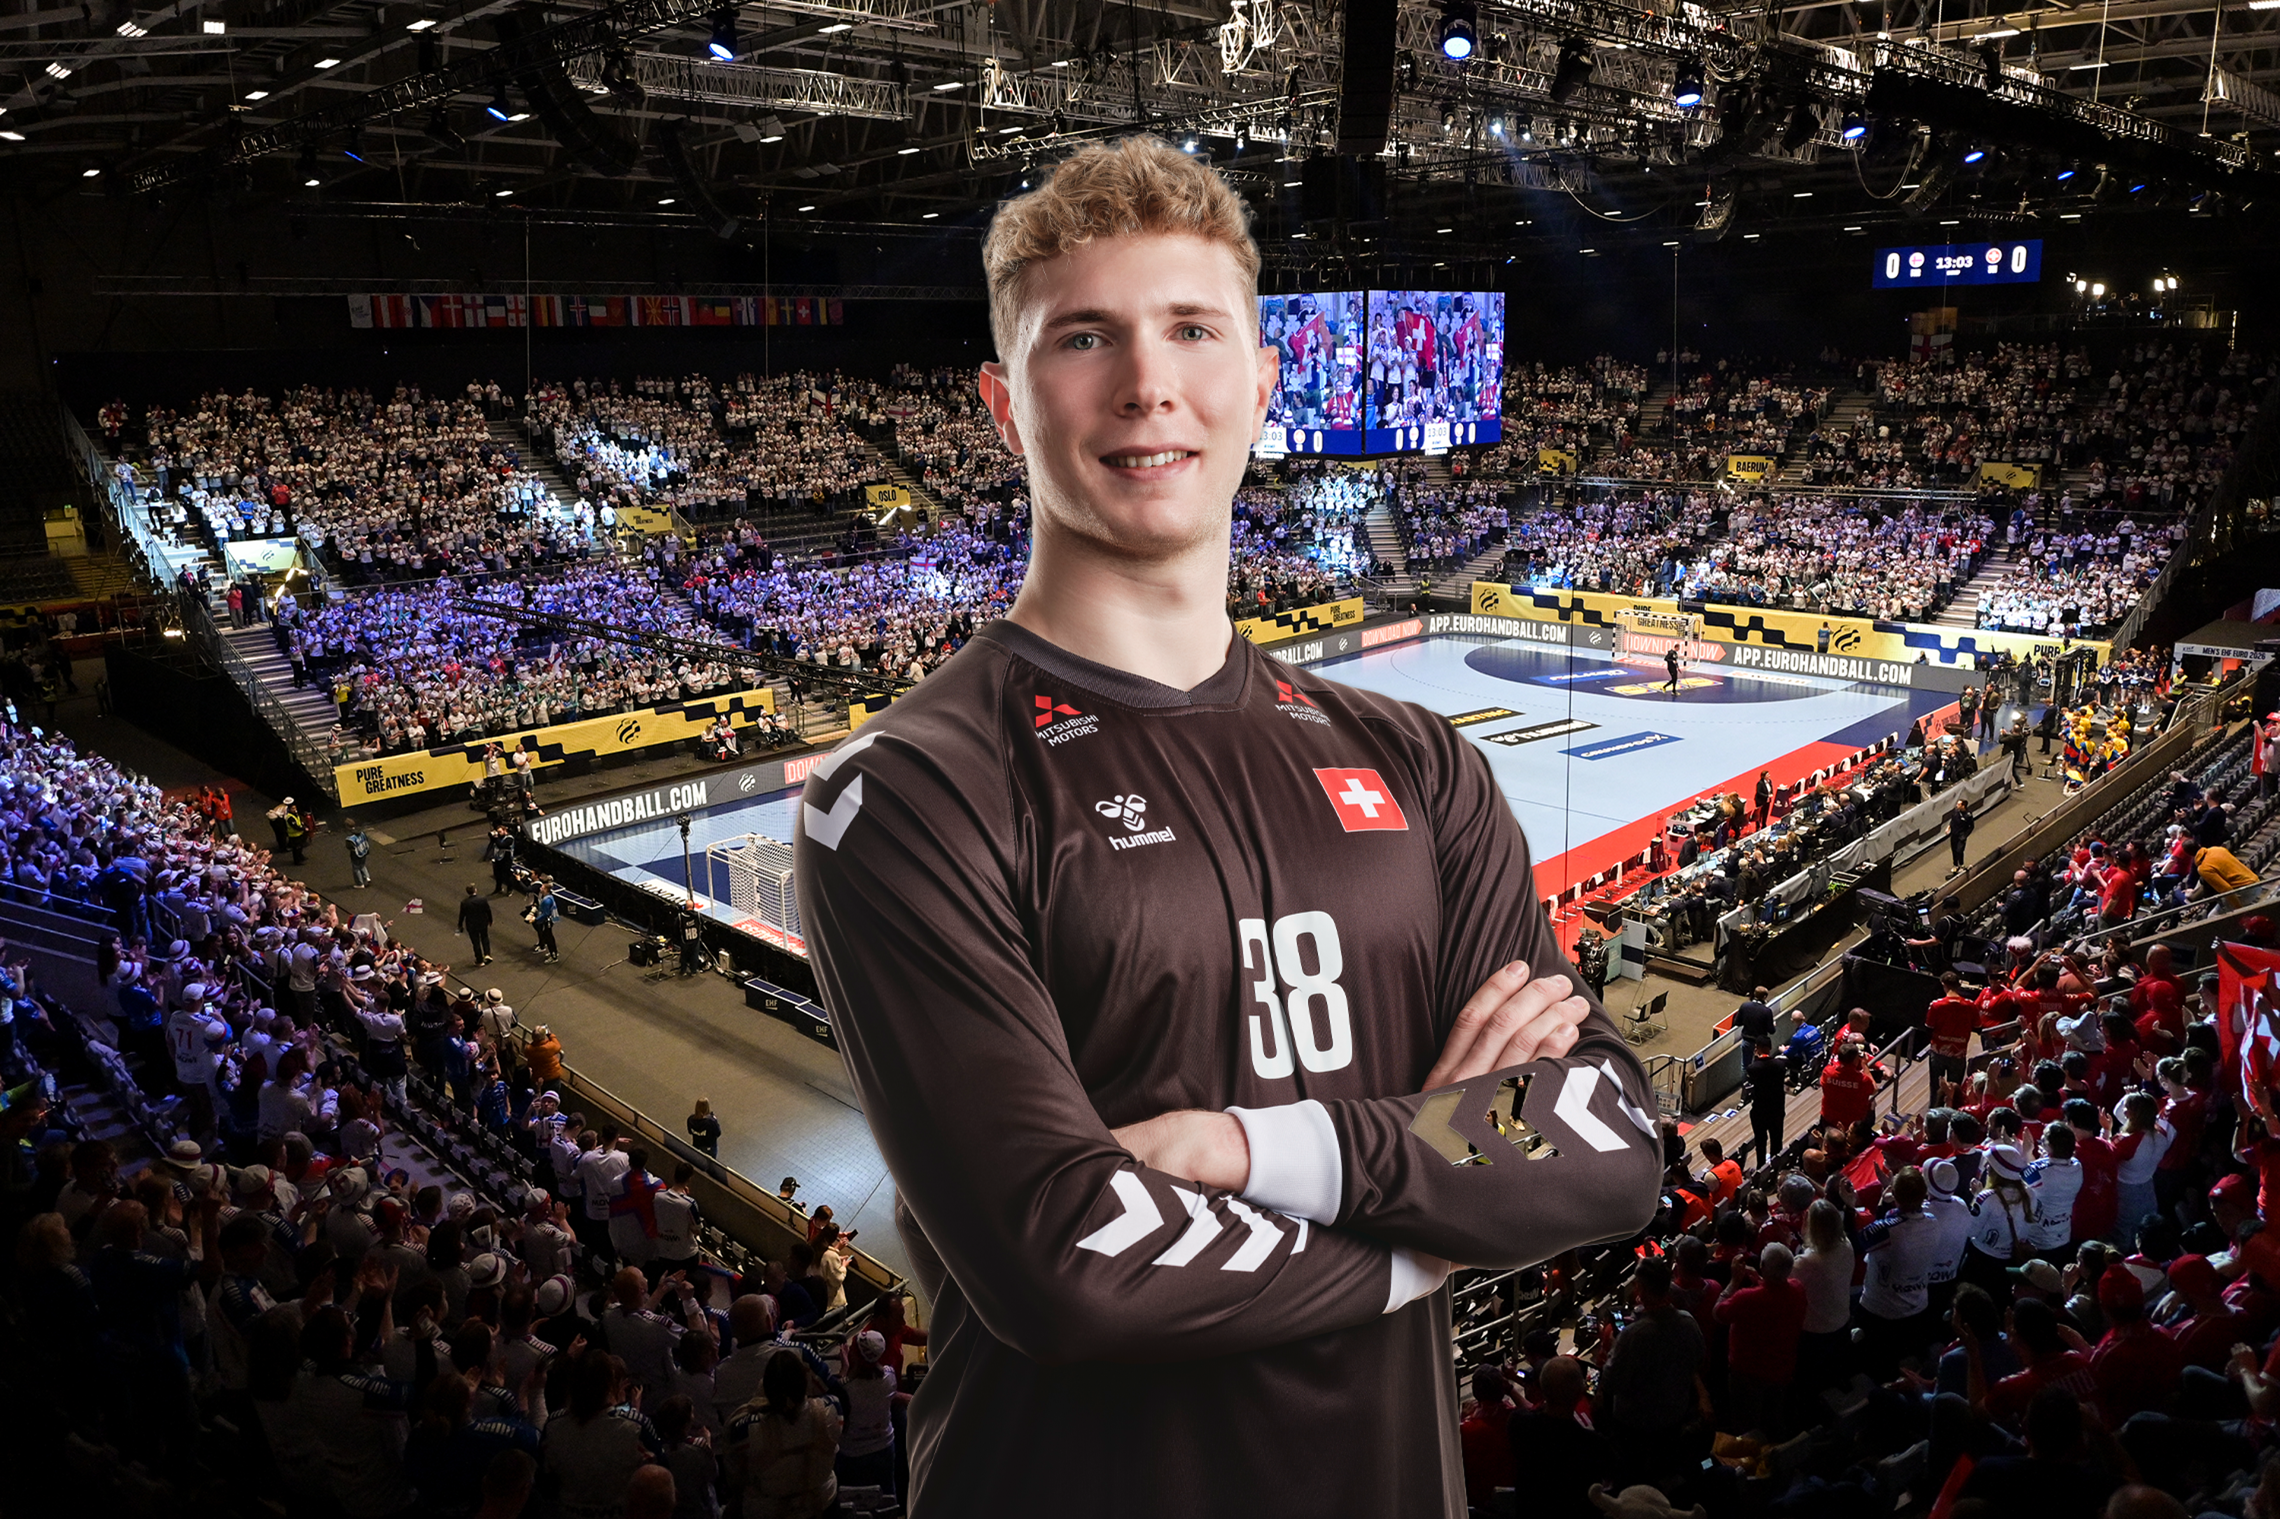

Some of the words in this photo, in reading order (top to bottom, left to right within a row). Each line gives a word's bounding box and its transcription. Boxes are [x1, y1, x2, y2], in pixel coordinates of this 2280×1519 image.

[1886, 253, 1900, 279] 0
[1936, 256, 1973, 269] 13:03
[2011, 245, 2027, 273] 0
[1260, 431, 1283, 441] 3:03
[878, 489, 897, 502] OSLO
[1333, 610, 1356, 622] GREATNESS
[1363, 626, 1401, 646] DOWNLOAD
[1403, 621, 1420, 636] NOW
[1429, 615, 1567, 643] APP.EUROHANDBALL.COM
[1691, 643, 1719, 660] NOW
[2202, 647, 2220, 655] MEN'S
[2221, 648, 2232, 657] EHF
[2232, 650, 2249, 658] EURO
[2249, 651, 2266, 660] 2026
[1733, 646, 1913, 686] APP.EUROHANDBALL.COM
[1034, 714, 1100, 739] MITSUBISHI
[1047, 723, 1099, 747] MOTORS
[356, 765, 384, 783] PURE
[365, 770, 425, 794] GREATNESS
[531, 781, 708, 845] EUROHANDBALL.COM
[1108, 825, 1177, 851] hummel
[685, 927, 698, 940] HB
[765, 999, 778, 1007] EHF
[1239, 910, 1353, 1080] 38
[175, 1028, 193, 1050] 71
[1826, 1077, 1860, 1090] SUISSE
